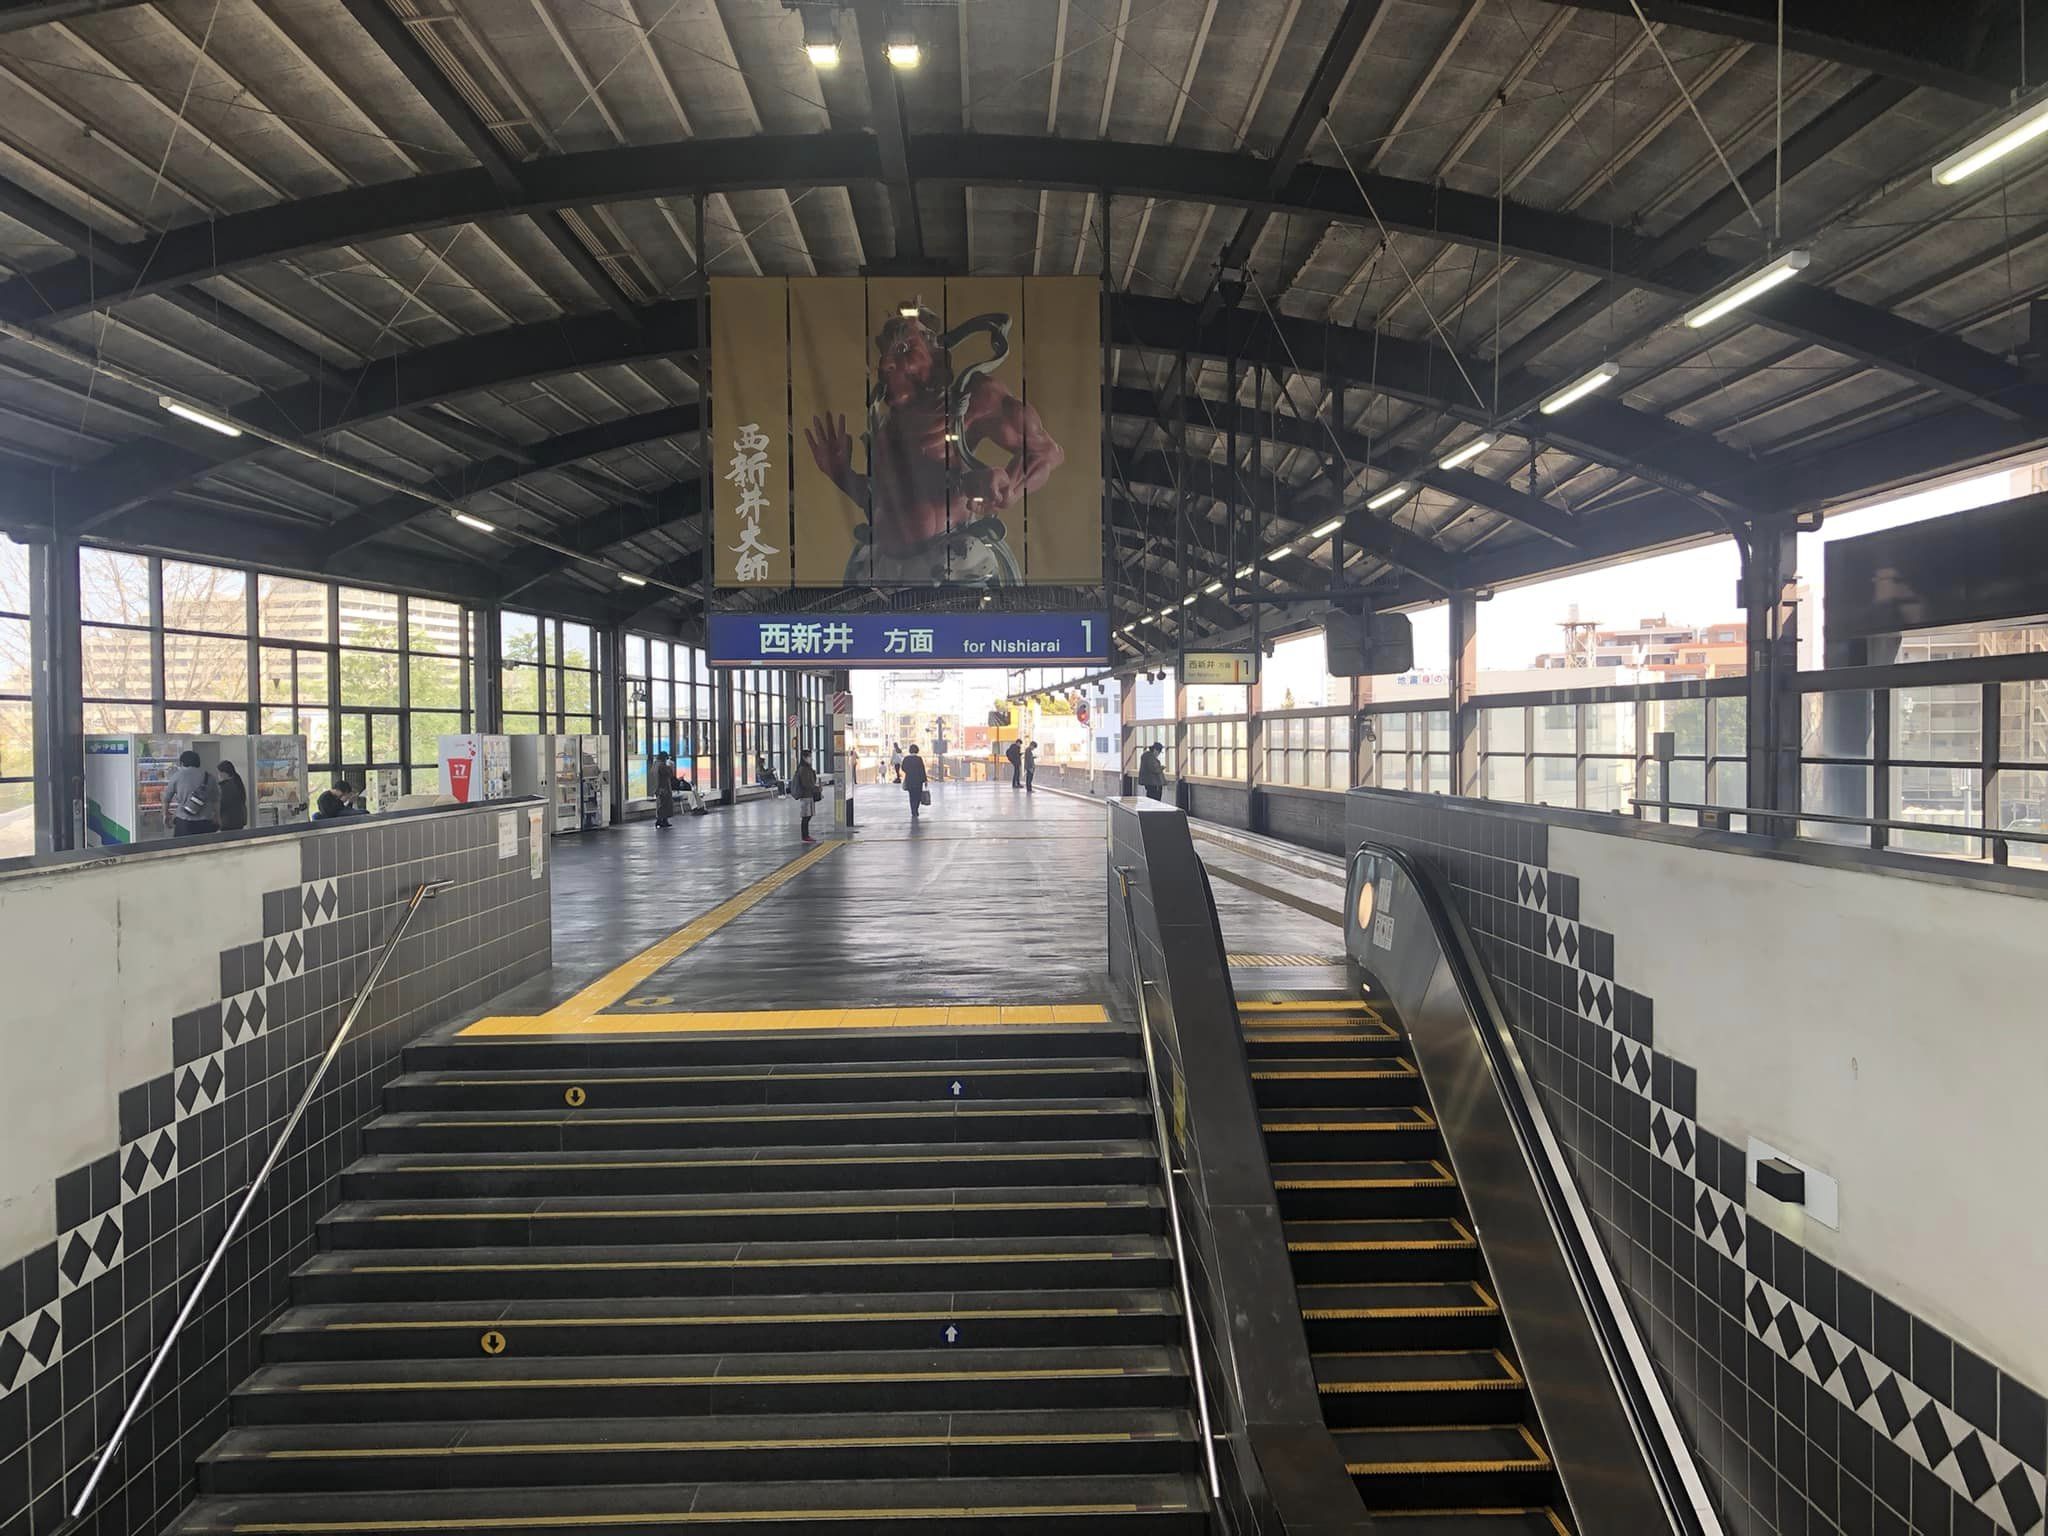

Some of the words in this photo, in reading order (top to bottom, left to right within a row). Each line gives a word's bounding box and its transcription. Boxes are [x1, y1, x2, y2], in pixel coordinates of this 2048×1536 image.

[723, 423, 780, 582] 西新井大師
[759, 622, 854, 654] 西新井
[884, 628, 934, 653] 方面
[963, 639, 986, 653] for
[991, 639, 1060, 653] Nishiarai
[1081, 619, 1092, 653] 1
[1243, 660, 1249, 675] 1
